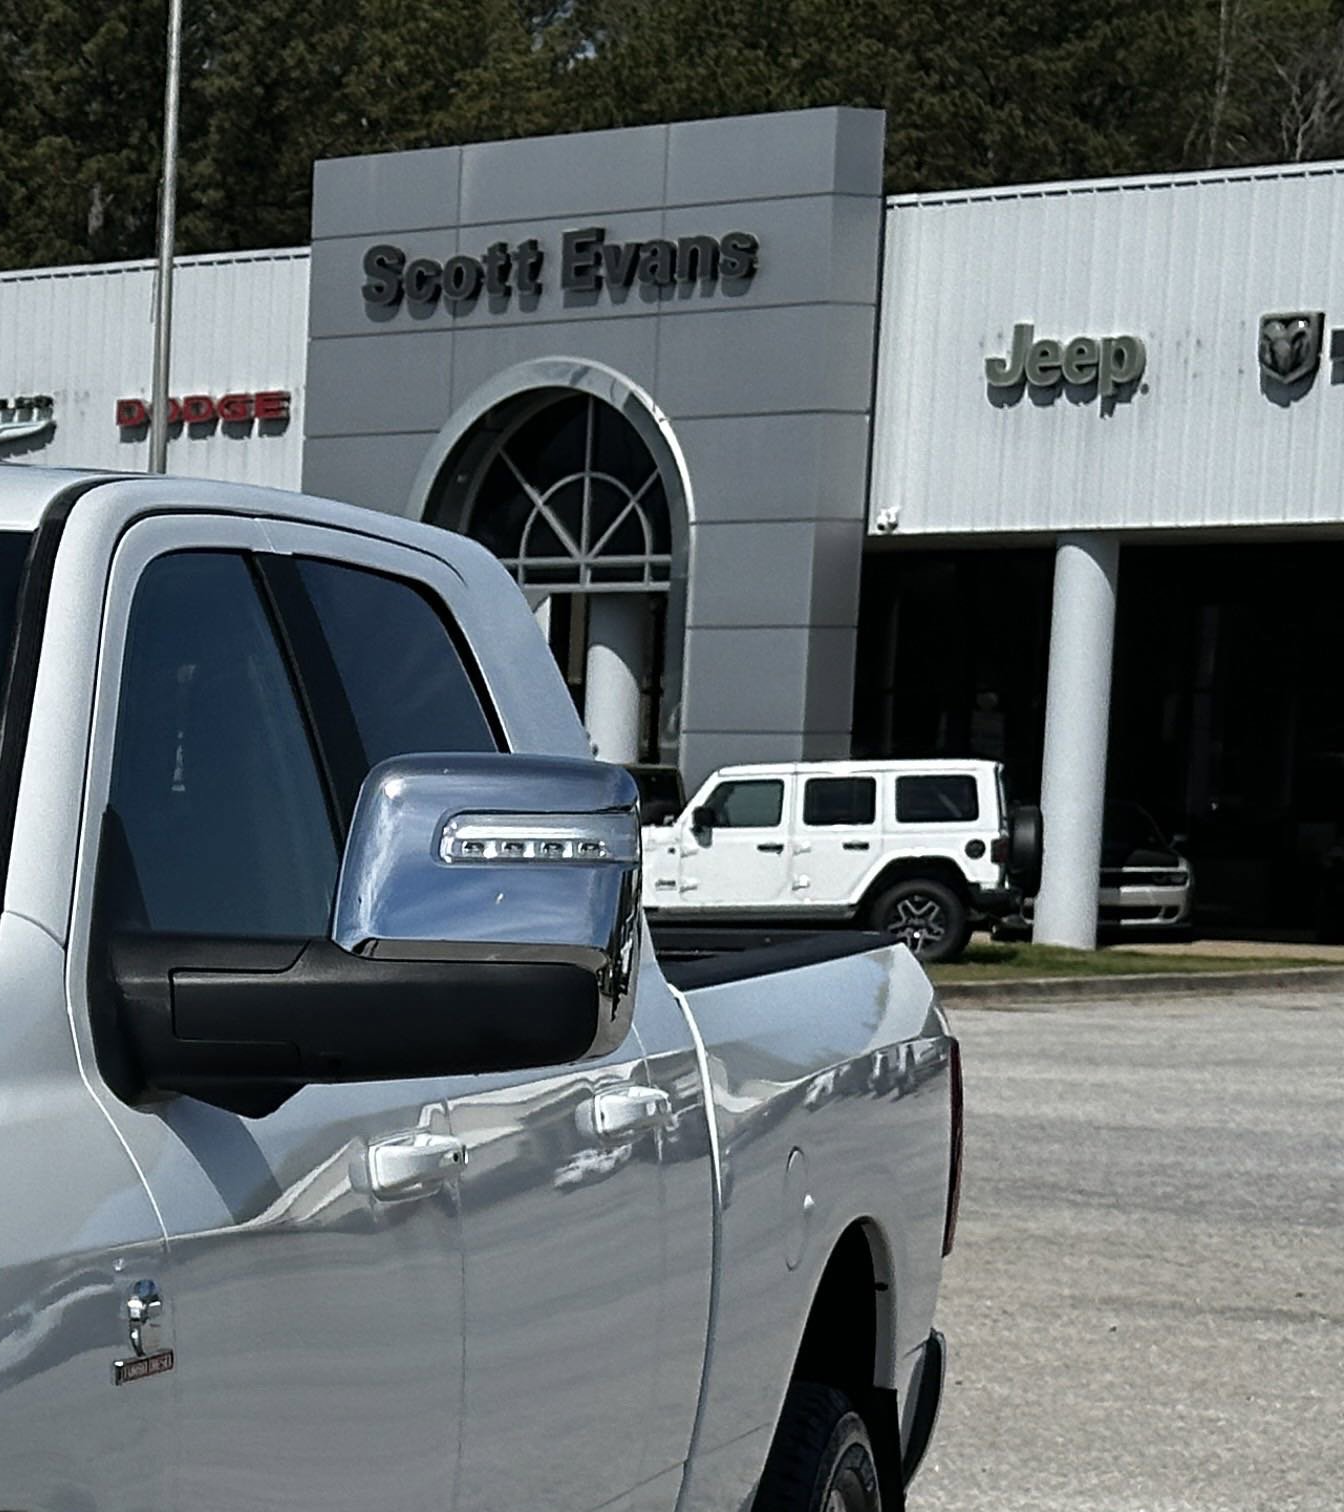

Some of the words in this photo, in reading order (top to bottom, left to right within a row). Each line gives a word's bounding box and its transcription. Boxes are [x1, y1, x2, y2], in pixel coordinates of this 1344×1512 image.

[361, 238, 544, 304] Scott
[560, 226, 761, 293] Evans
[984, 322, 1148, 397] Jeep
